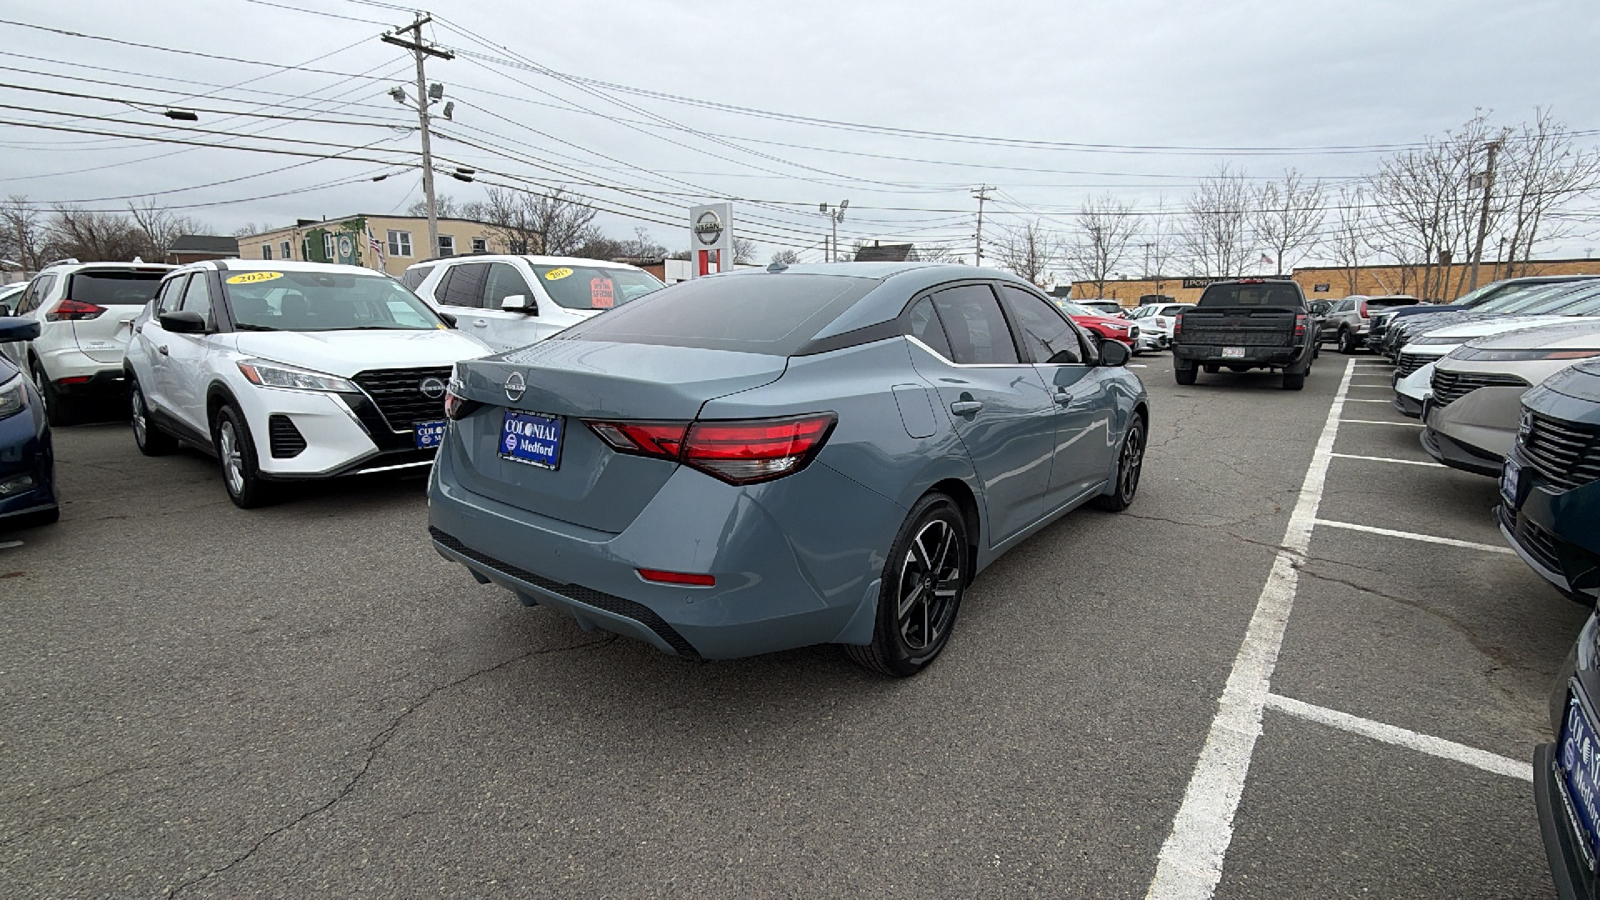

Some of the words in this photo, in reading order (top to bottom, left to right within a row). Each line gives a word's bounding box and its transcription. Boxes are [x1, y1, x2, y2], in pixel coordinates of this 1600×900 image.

[695, 222, 720, 231] NISSAN
[239, 272, 274, 282] 2023
[505, 419, 557, 442] COLONIAL
[519, 439, 554, 457] Medford
[1568, 706, 1600, 792] COLONI
